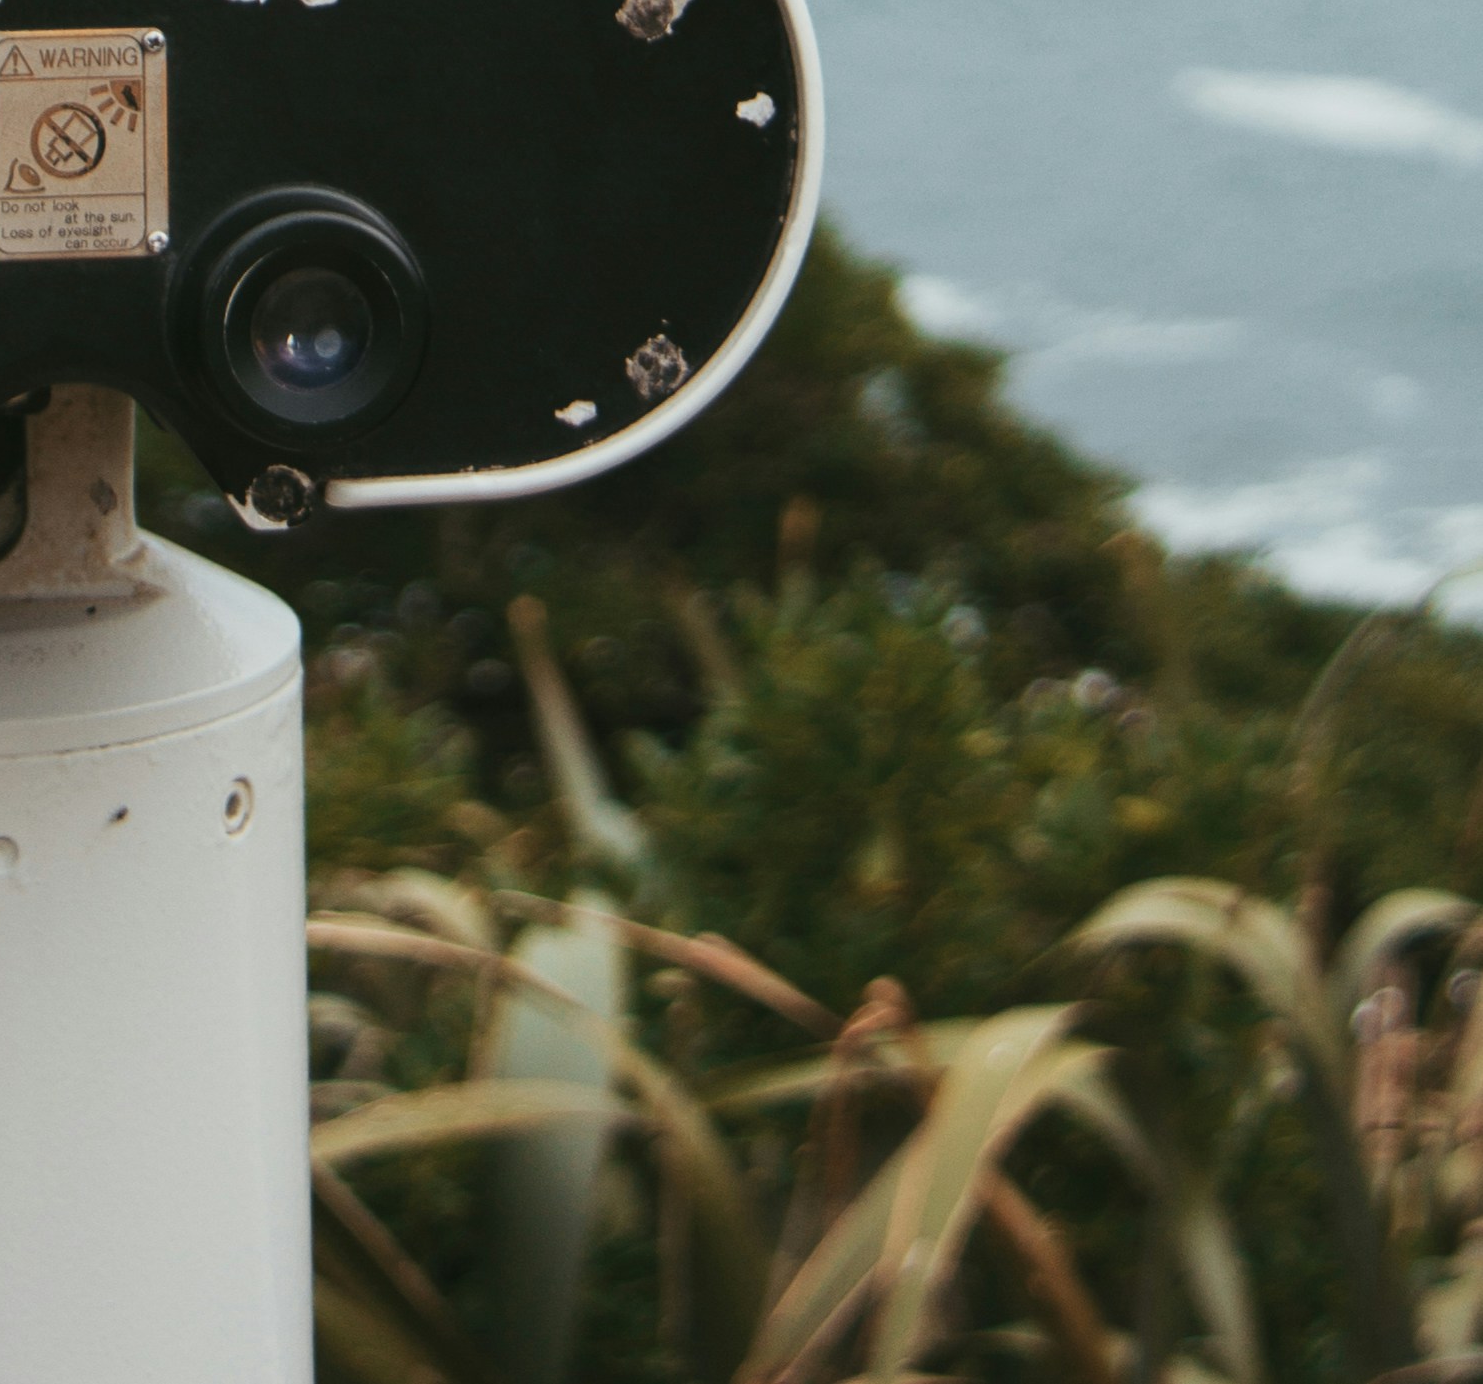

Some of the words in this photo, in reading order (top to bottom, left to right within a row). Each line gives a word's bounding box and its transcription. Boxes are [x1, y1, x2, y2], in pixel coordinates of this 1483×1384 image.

[39, 46, 138, 68] WARNING
[1, 201, 18, 214] Do
[24, 200, 46, 213] not
[53, 199, 80, 211] look
[65, 213, 78, 224] at
[85, 211, 105, 223] the
[110, 211, 136, 223] sun.
[1, 227, 33, 239] Loss
[39, 225, 52, 237] of
[58, 224, 113, 239] eyesight
[65, 238, 88, 249] can
